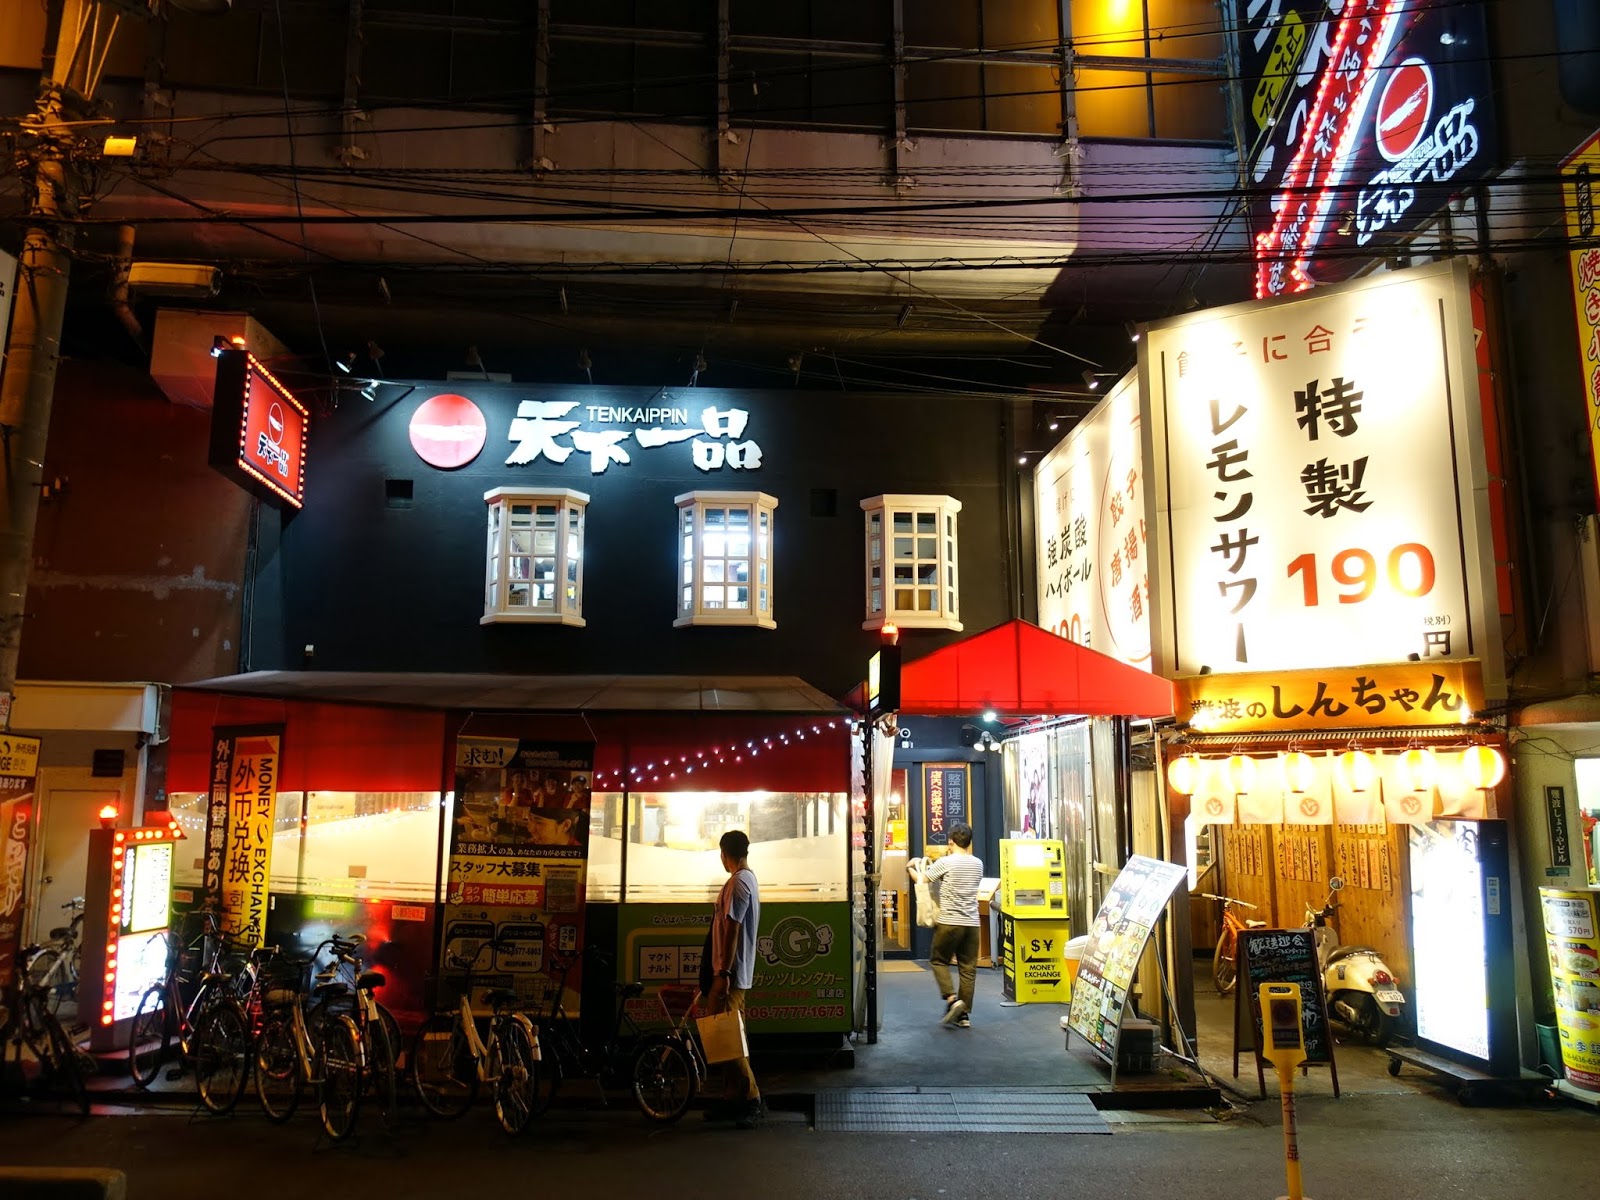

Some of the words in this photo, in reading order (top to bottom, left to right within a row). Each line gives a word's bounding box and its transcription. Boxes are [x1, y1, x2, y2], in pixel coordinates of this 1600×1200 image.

[586, 406, 688, 425] TENKAIPPIN
[257, 431, 289, 477] 天下一品
[505, 400, 764, 474] 天下一品
[1293, 376, 1374, 519] 特製
[1109, 468, 1137, 528] 餃子
[1206, 398, 1260, 664] レモンサワー
[1046, 557, 1092, 600] ハイボール
[1286, 542, 1436, 607] 190
[1422, 630, 1452, 657] 円
[257, 758, 273, 819] MONEY
[948, 773, 961, 815] 整理券
[229, 758, 256, 884] 外币兑换
[450, 860, 541, 877] スタッフ大募集
[247, 848, 266, 945] EXCHANGE
[482, 887, 540, 905] 簡単応募
[648, 953, 671, 962] マクド
[648, 964, 671, 973] ナルド
[752, 971, 845, 988] ガッツレンタカー
[816, 988, 845, 999] 難波店
[749, 1005, 845, 1020] 06-7777-1673
